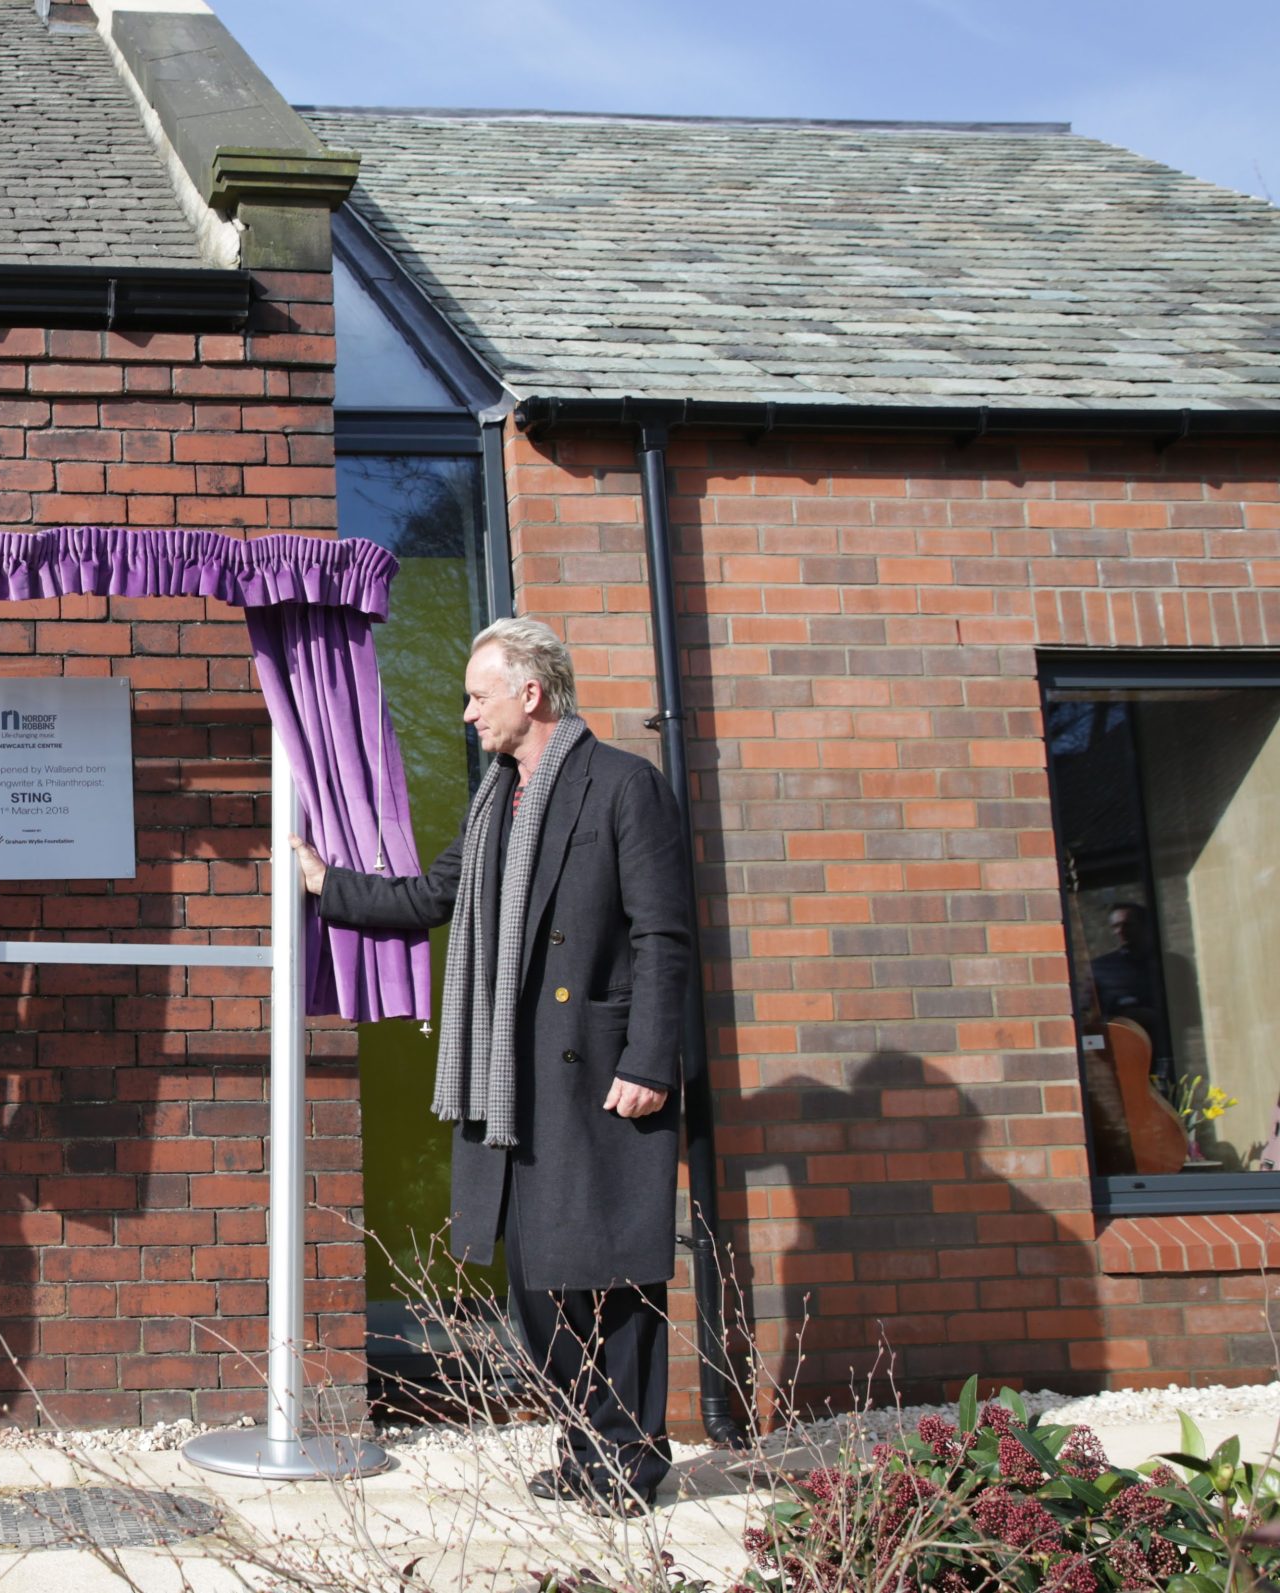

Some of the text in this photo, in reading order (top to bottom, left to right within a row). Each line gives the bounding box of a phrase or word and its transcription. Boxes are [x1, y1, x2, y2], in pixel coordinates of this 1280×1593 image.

[22, 714, 58, 722] NORDOFF
[31, 765, 41, 775] by
[44, 764, 82, 774] Wallsend
[86, 764, 106, 774] born
[37, 779, 42, 788] &
[10, 792, 52, 804] STING
[11, 806, 42, 815] March
[46, 806, 70, 815] 2018
